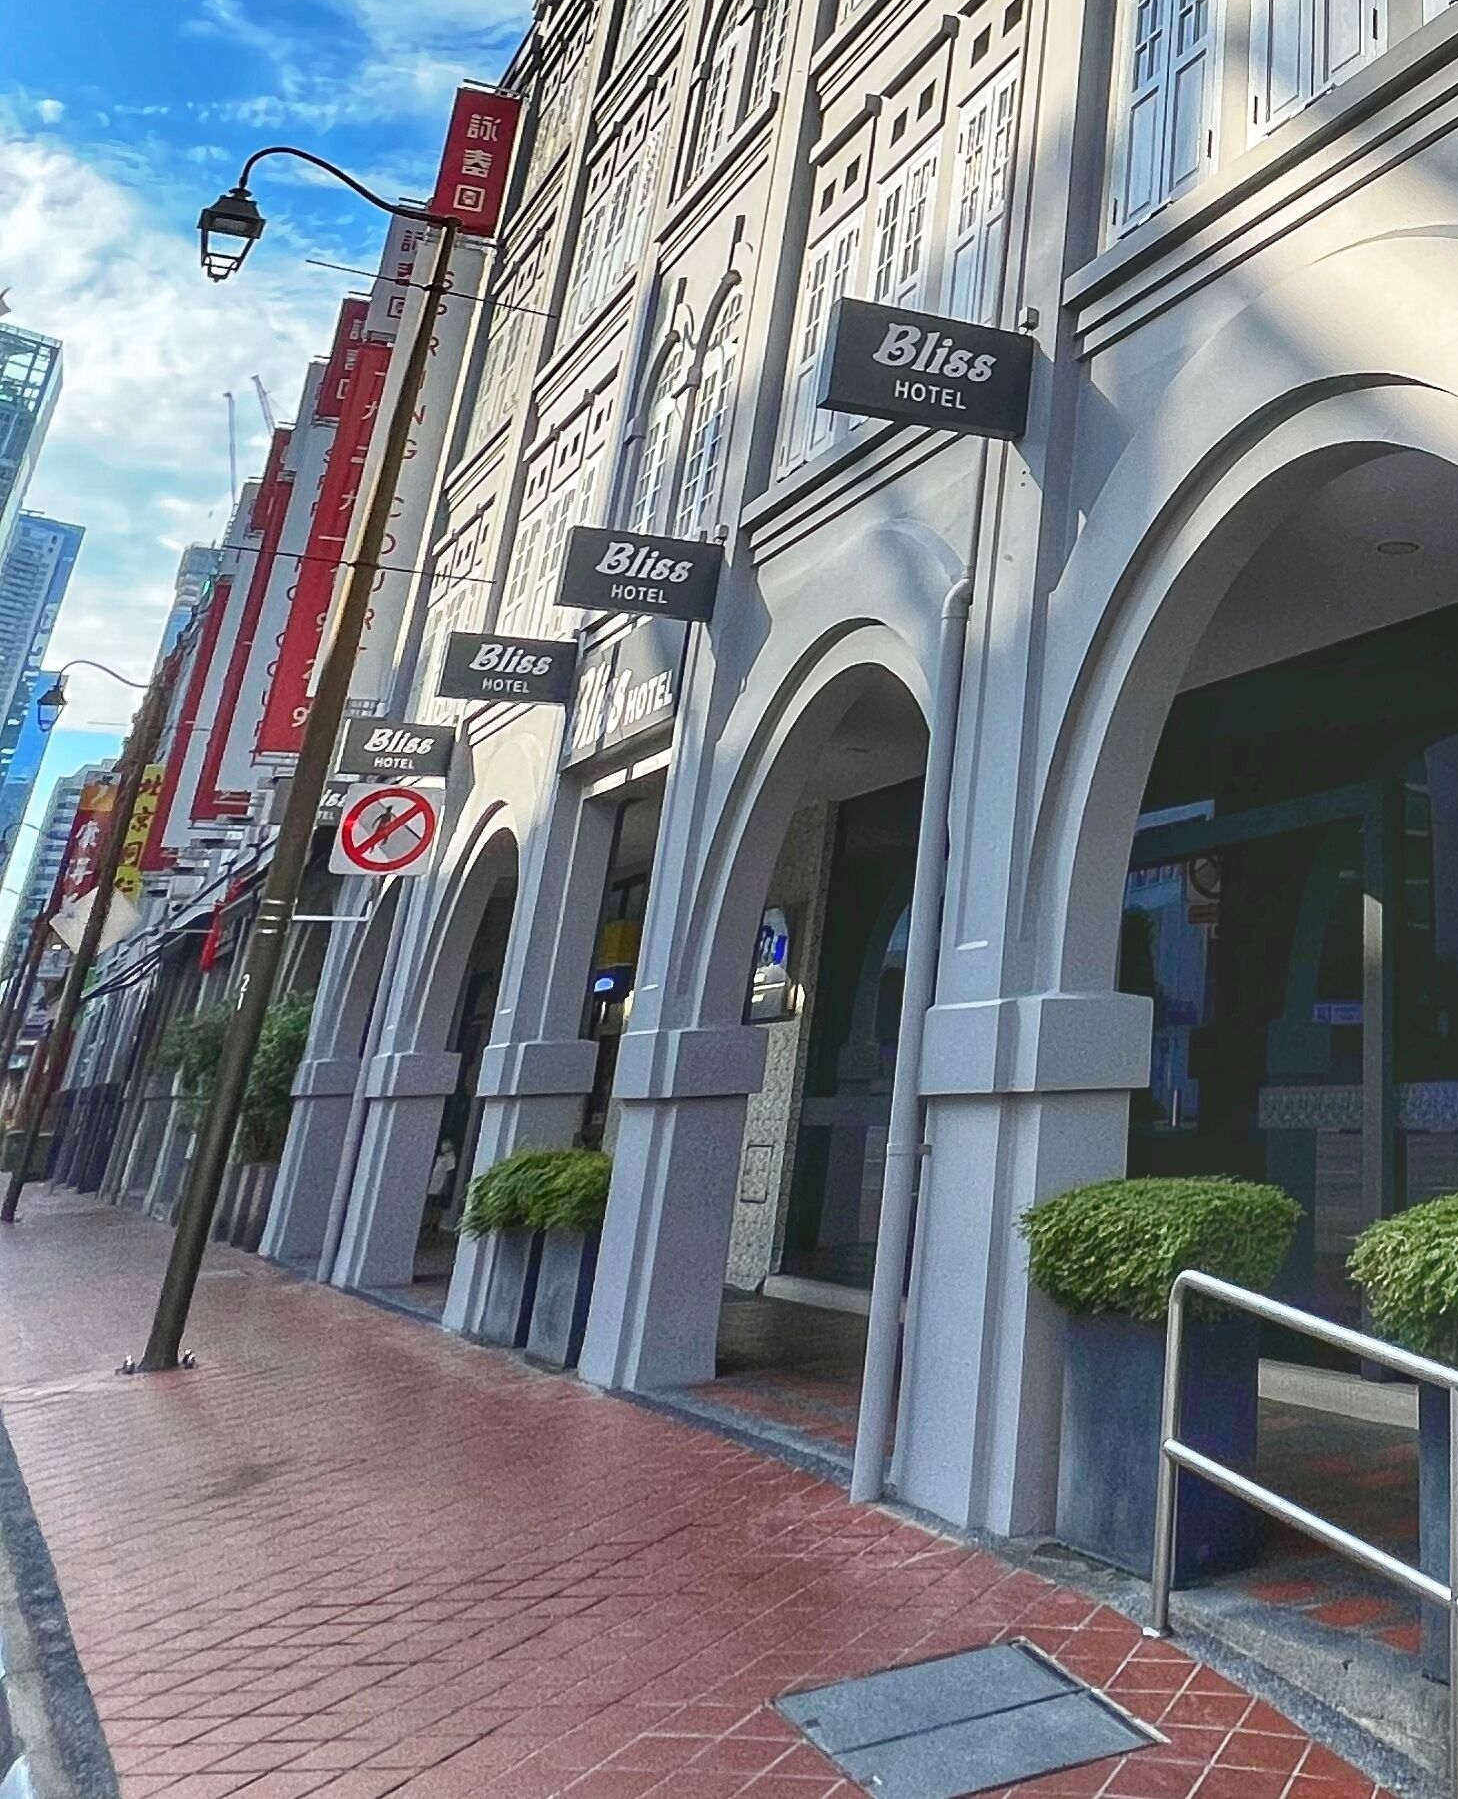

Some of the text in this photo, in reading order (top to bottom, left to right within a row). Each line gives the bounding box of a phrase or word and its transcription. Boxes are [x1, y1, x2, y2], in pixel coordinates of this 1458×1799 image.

[872, 322, 998, 382] Bliss
[894, 380, 967, 410] HOTEL
[595, 542, 693, 583] Bliss
[611, 584, 668, 604] HOTEL
[469, 643, 553, 675] Bliss
[481, 677, 530, 694] HOTEL
[623, 668, 674, 726] HOTEL
[363, 728, 436, 755] Bliss
[373, 757, 415, 770] HOTEL
